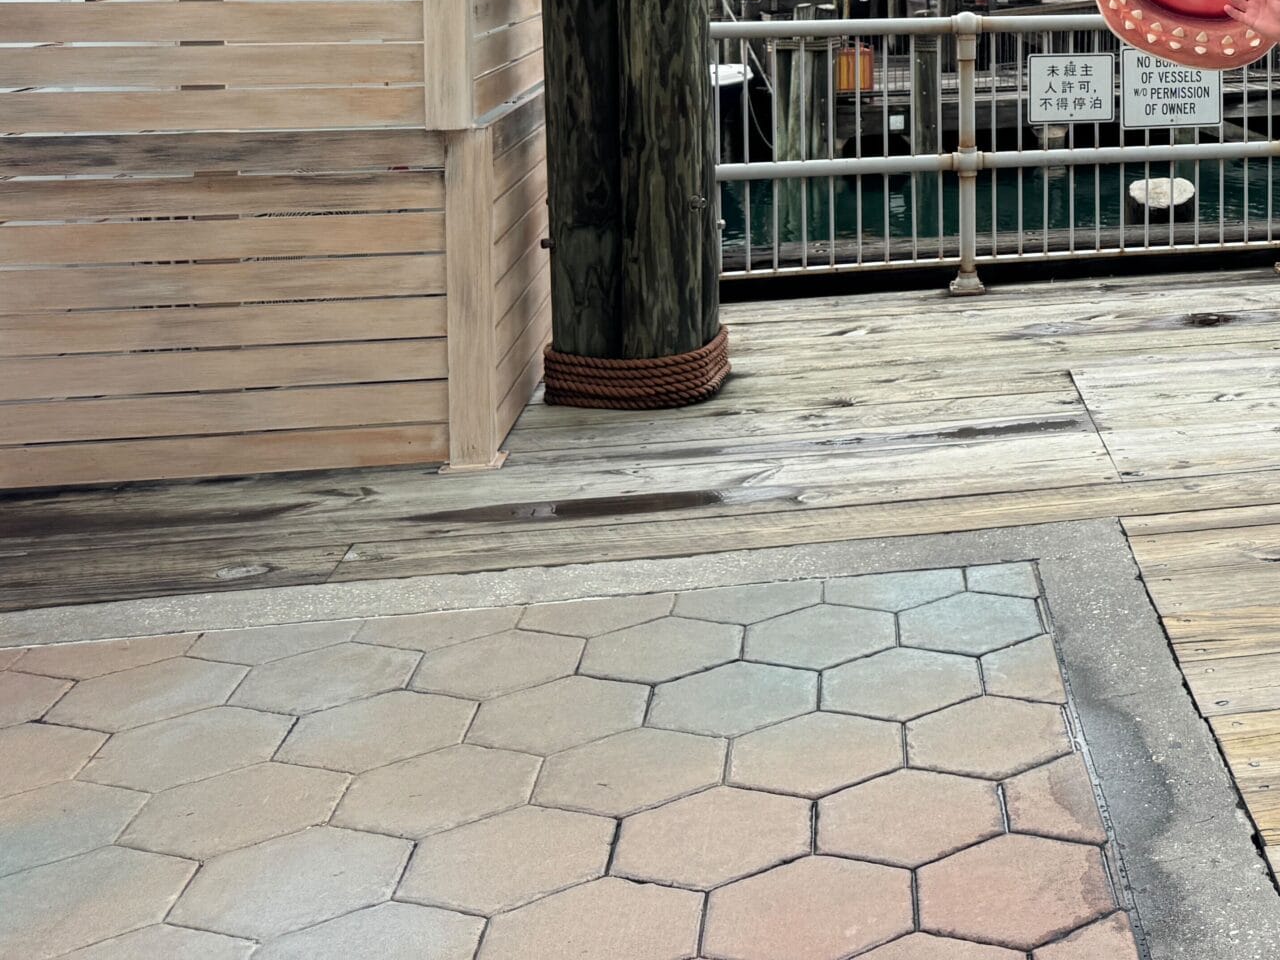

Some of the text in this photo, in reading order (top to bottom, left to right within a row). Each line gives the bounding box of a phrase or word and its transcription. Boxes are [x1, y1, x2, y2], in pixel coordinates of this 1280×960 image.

[1137, 56, 1150, 68] NO
[1047, 64, 1094, 77] 未經主
[1141, 71, 1202, 84] OF VESSELS
[1150, 86, 1210, 100] PERMISSION
[1039, 97, 1102, 111] 不得停泊
[1144, 103, 1196, 116] OF OWNER
